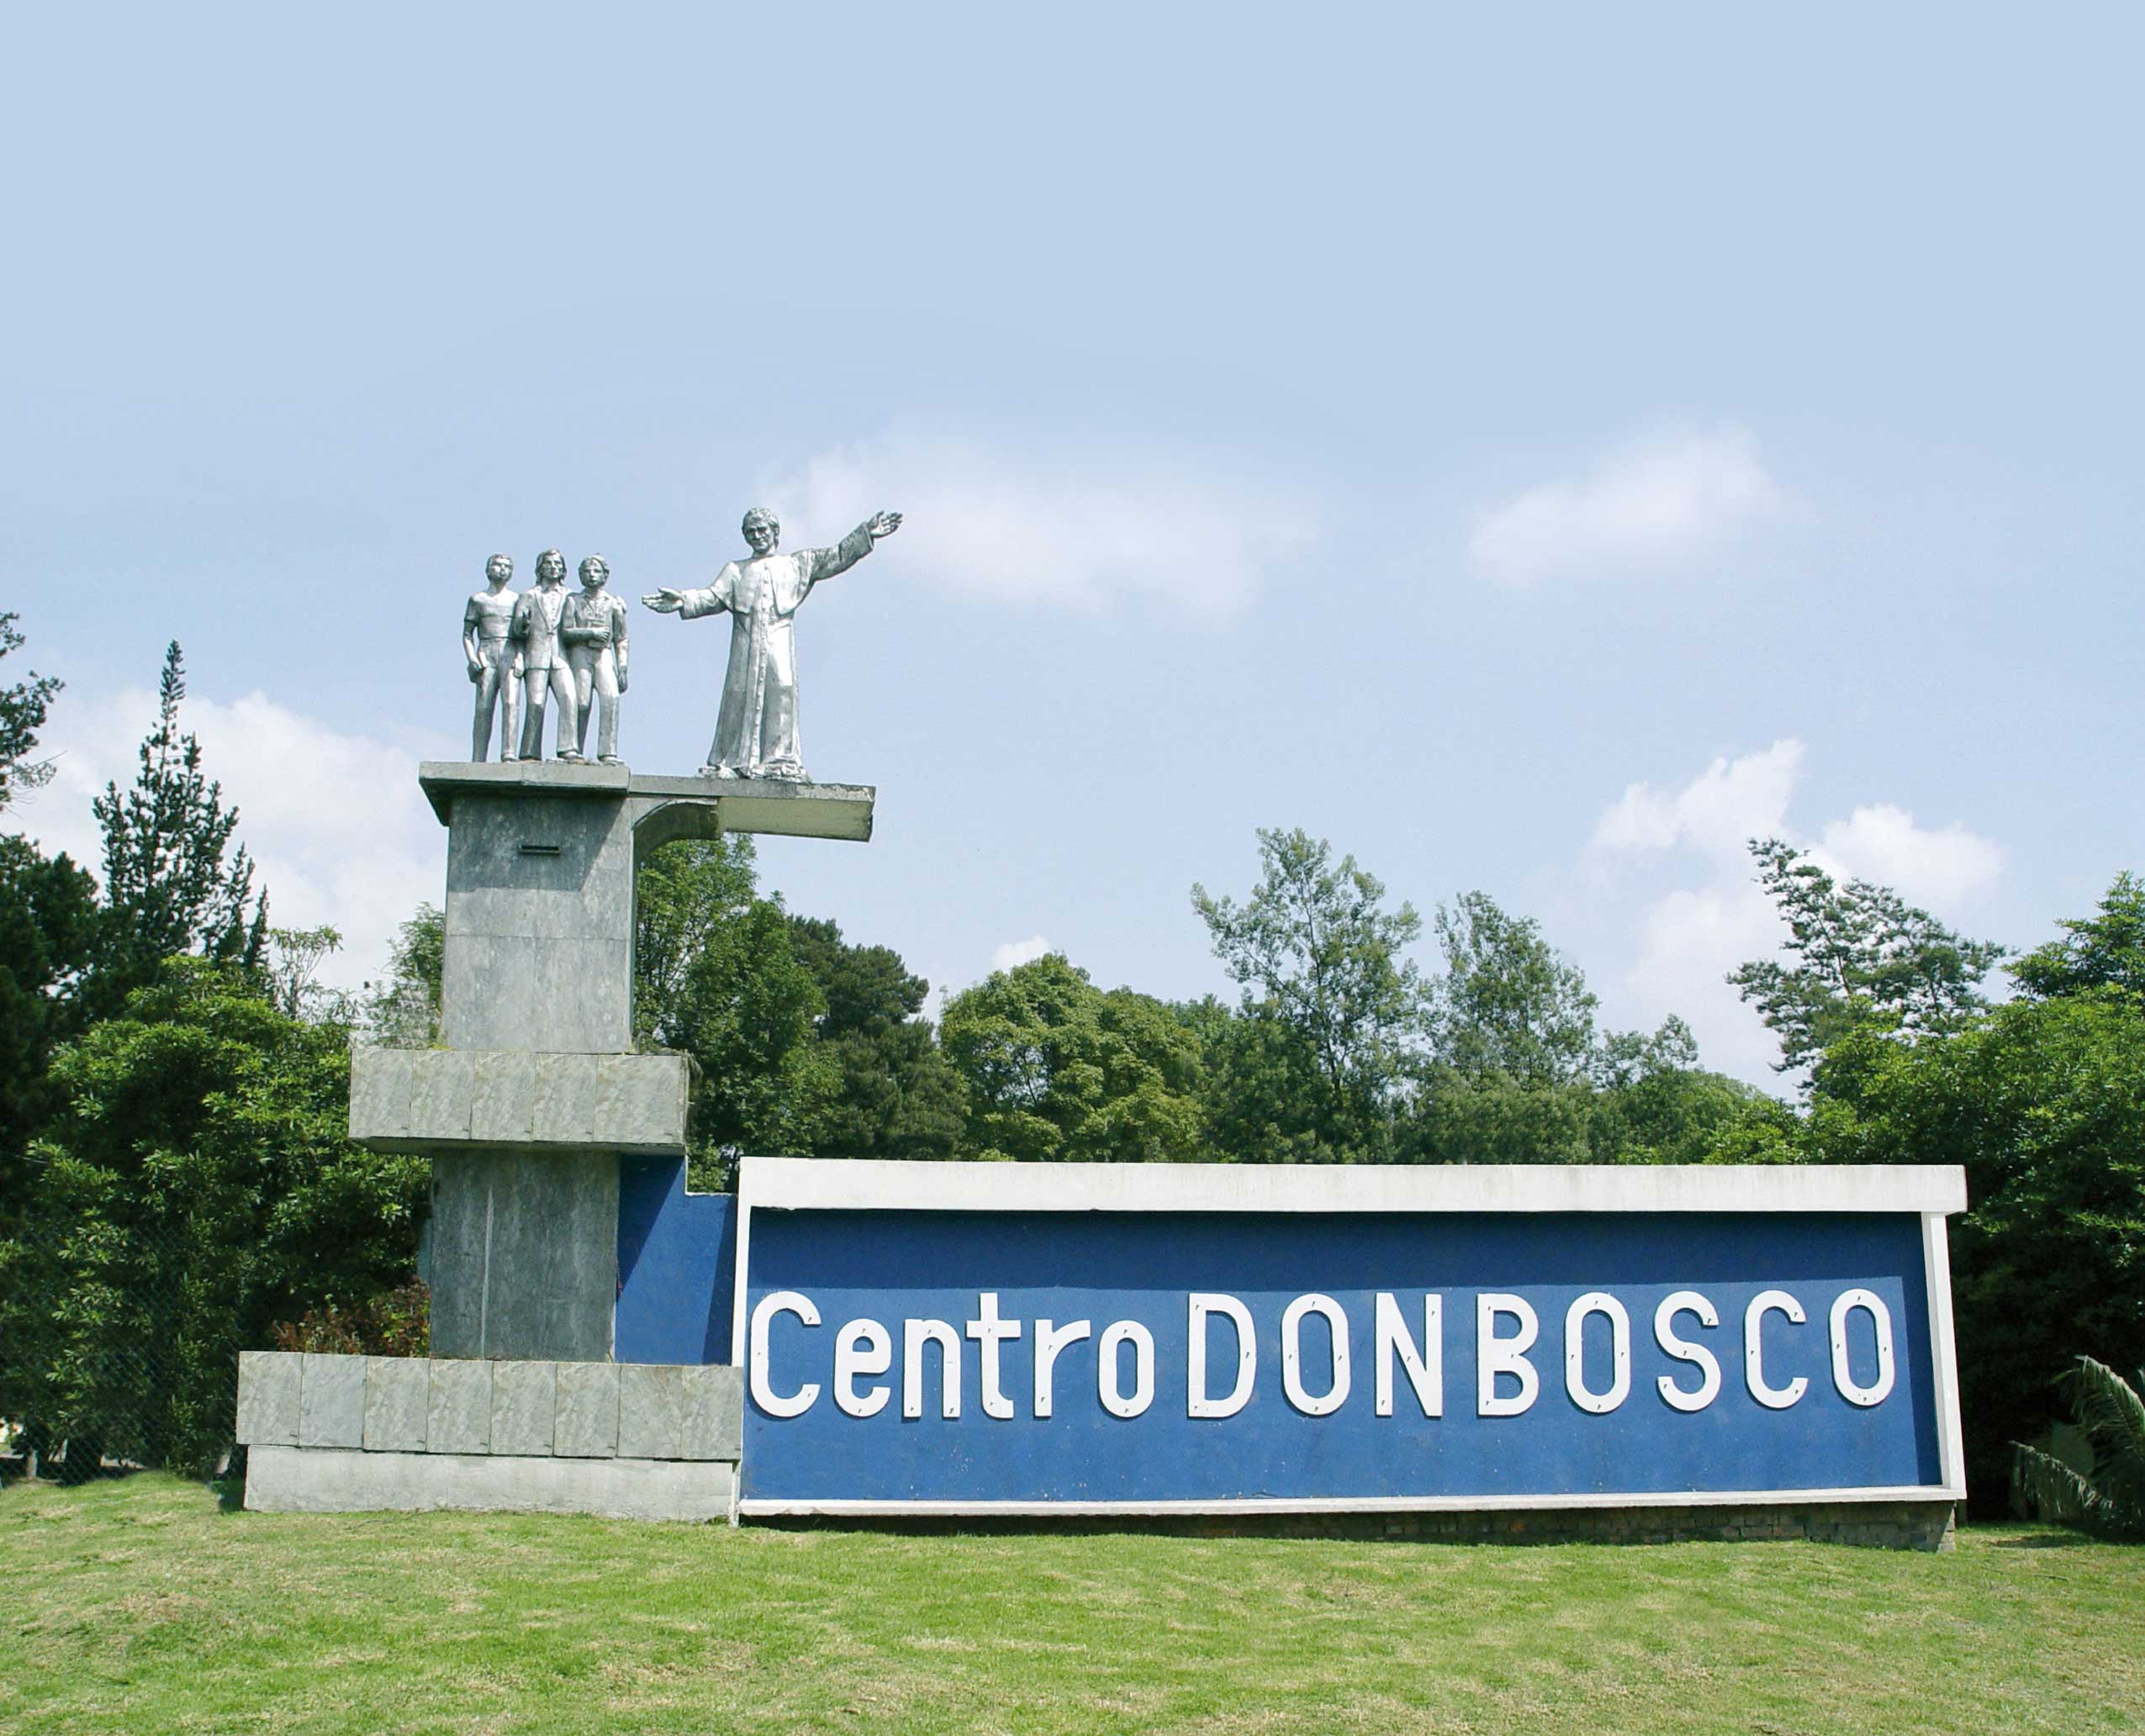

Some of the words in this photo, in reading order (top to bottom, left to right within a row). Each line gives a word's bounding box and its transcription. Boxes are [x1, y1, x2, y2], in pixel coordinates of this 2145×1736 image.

[750, 1290, 1154, 1418] Centro
[1188, 1292, 1443, 1417] DON
[1477, 1288, 1895, 1417] BOSCO
